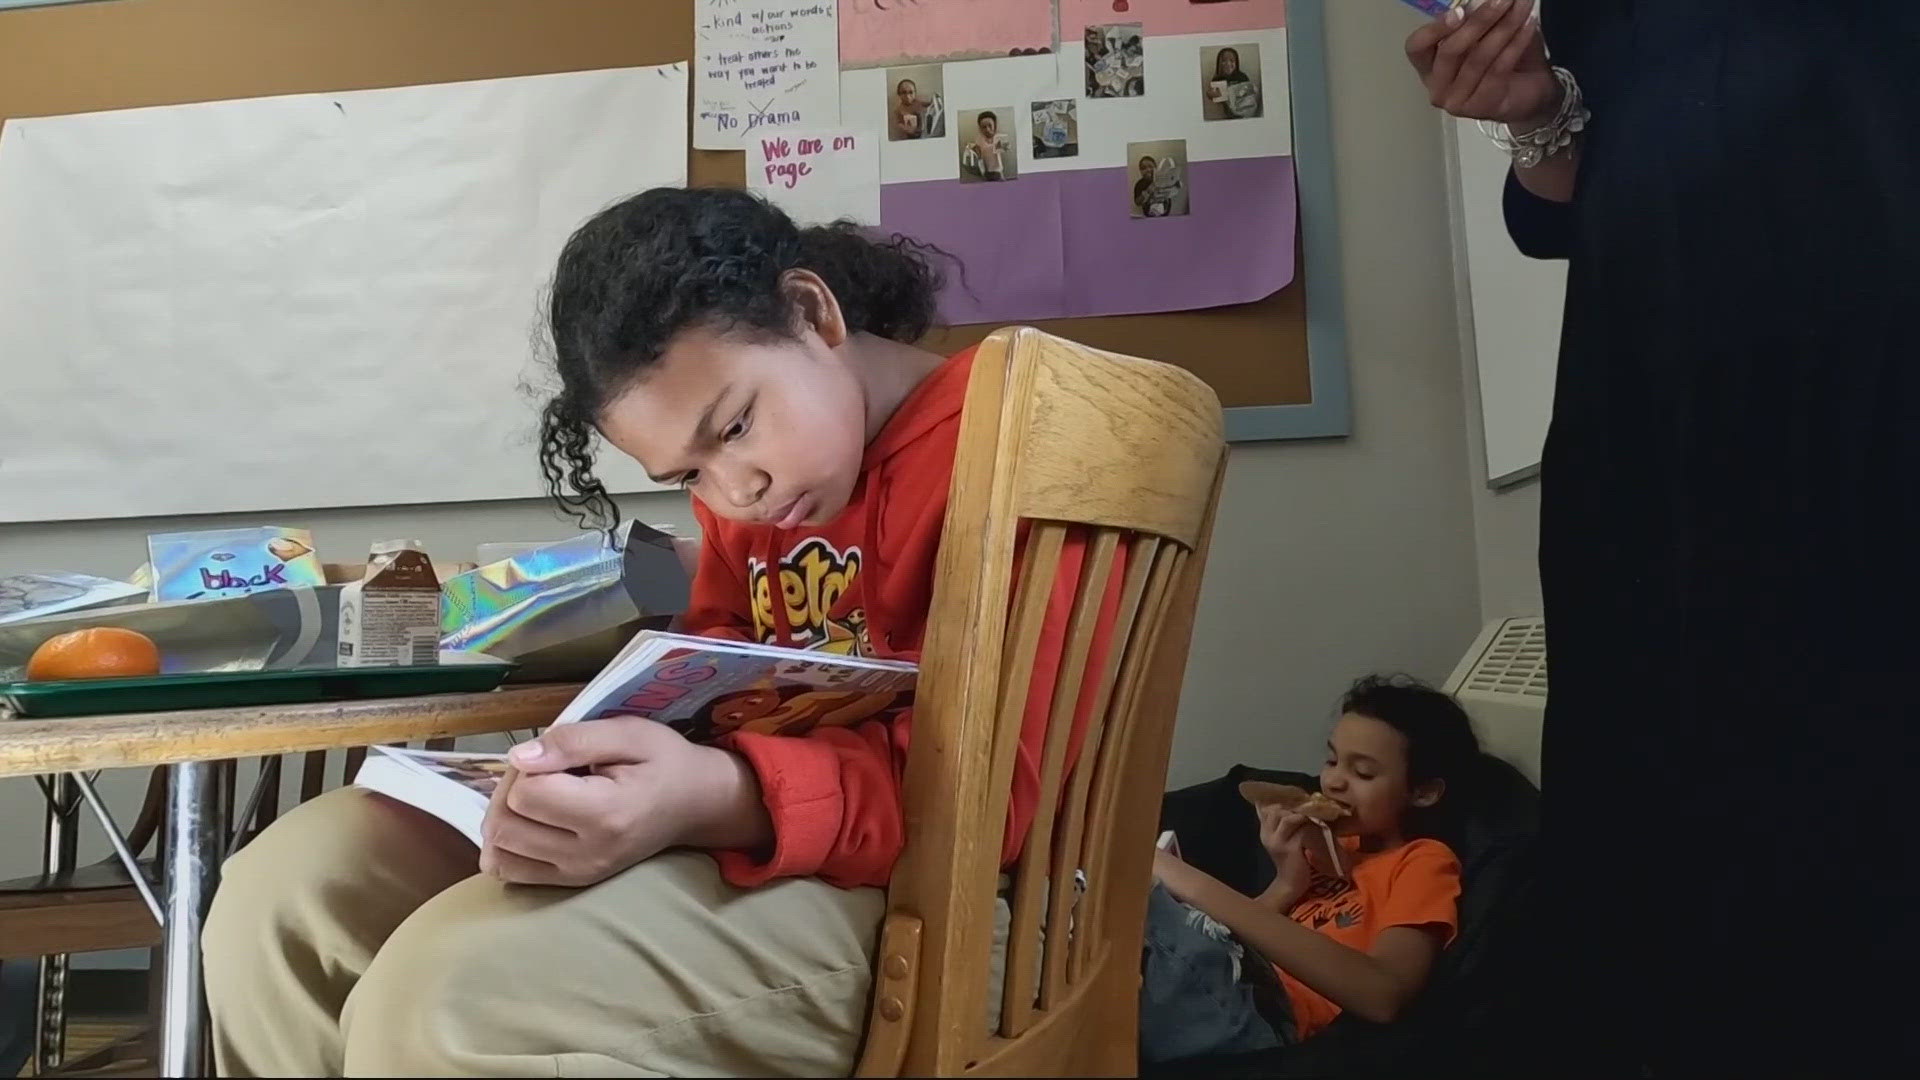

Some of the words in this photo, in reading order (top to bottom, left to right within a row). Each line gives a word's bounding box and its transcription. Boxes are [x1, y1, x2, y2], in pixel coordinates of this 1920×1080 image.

[767, 10, 784, 20] our
[790, 4, 824, 18] words
[751, 22, 793, 34] actions
[718, 51, 743, 65] treat
[708, 70, 730, 81] way
[738, 67, 755, 80] you
[761, 63, 787, 74] want
[744, 75, 776, 90] treated
[717, 113, 738, 132] No
[747, 110, 801, 129] Drama
[761, 137, 791, 162] We
[797, 139, 823, 155] are
[832, 136, 855, 151] on
